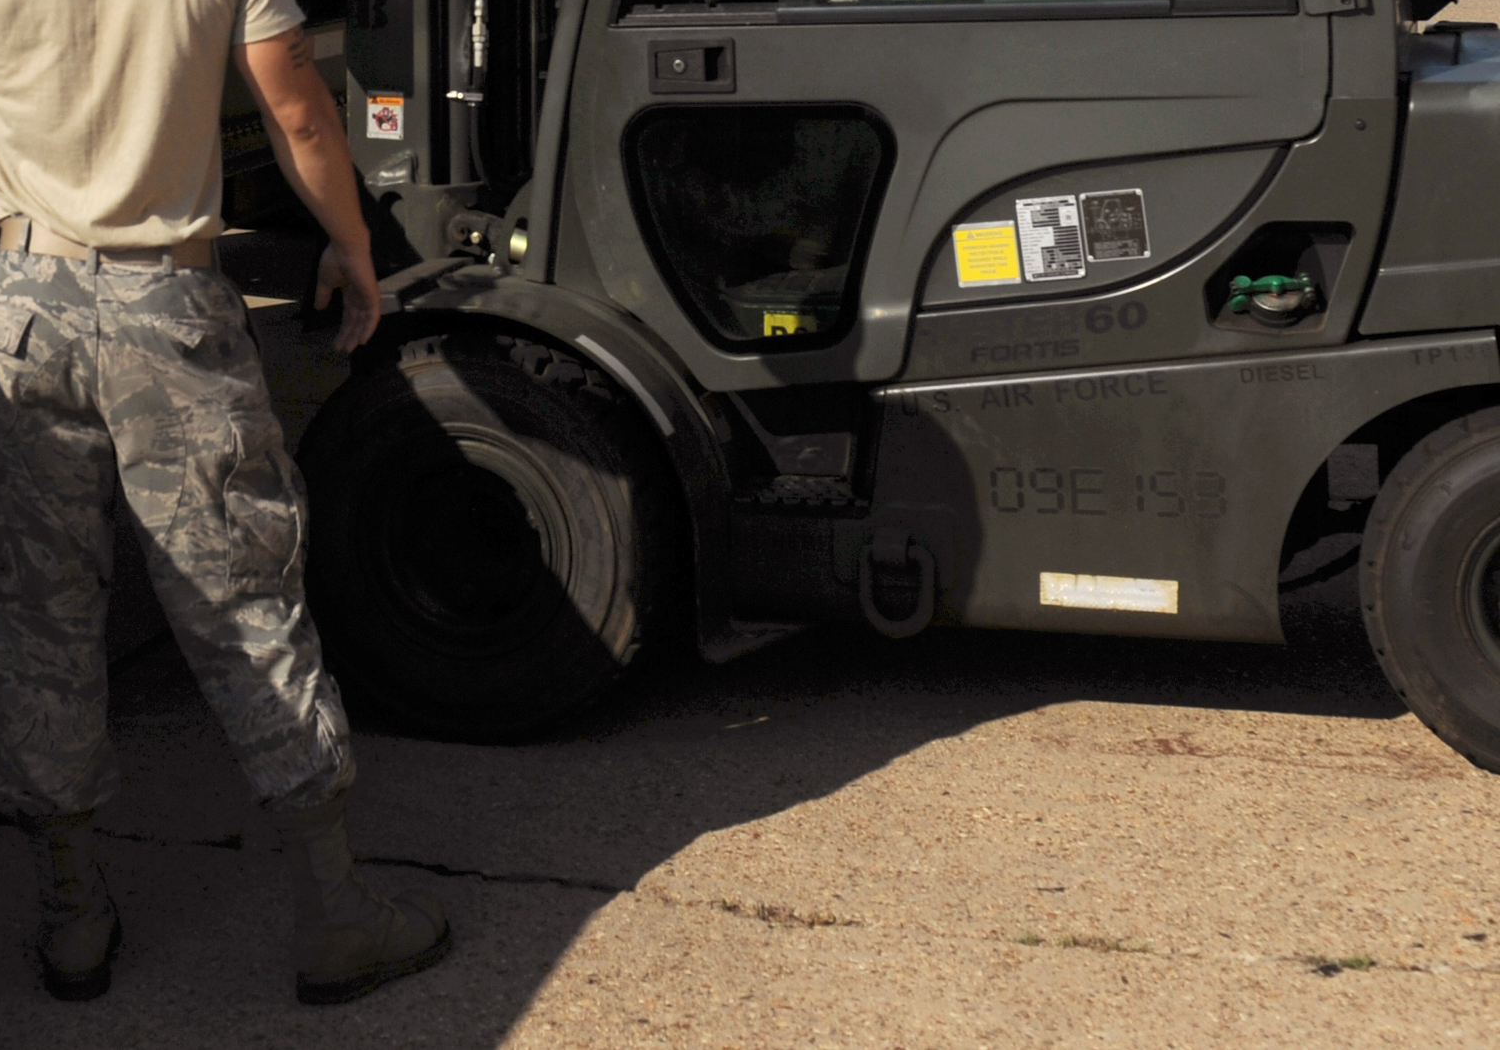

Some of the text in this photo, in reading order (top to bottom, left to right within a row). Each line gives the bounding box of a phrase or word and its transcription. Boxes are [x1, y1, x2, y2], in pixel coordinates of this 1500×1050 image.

[1084, 300, 1148, 334] 60
[970, 339, 1080, 364] FORTIS
[1240, 363, 1325, 384] DIESEL
[980, 383, 1035, 410] AIR
[1053, 370, 1169, 404] FORCE
